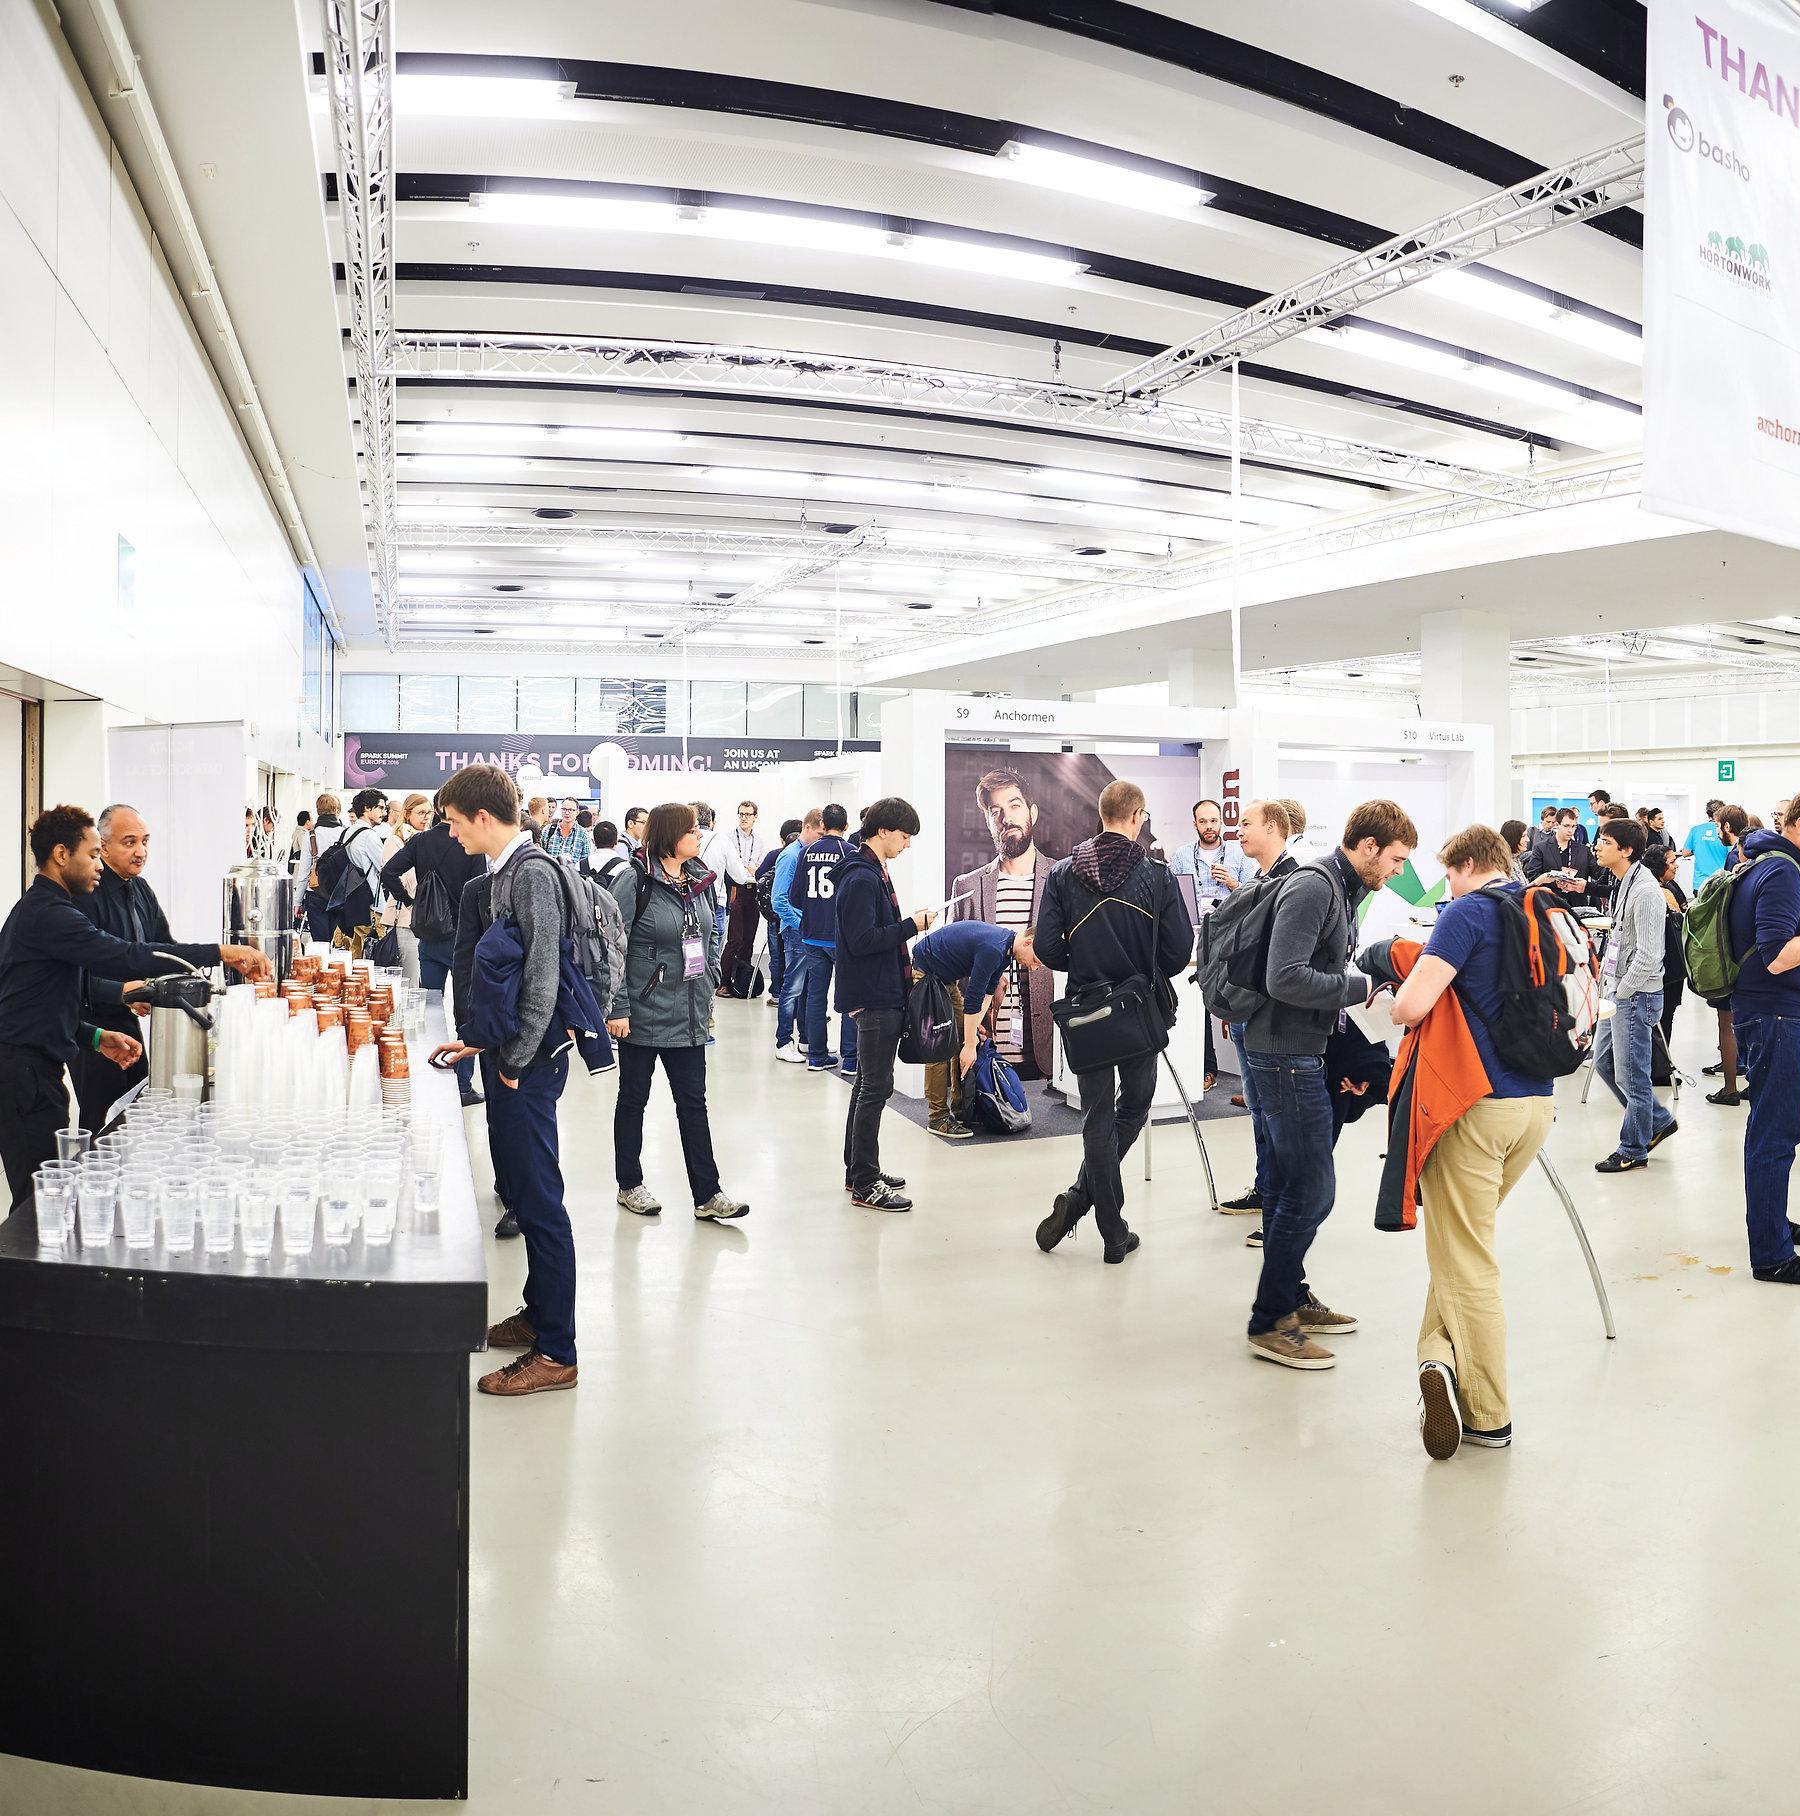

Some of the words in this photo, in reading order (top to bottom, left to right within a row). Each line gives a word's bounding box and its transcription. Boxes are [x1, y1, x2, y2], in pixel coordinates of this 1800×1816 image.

[1699, 131, 1750, 182] basho
[956, 707, 970, 719] S9
[994, 710, 1055, 722] Anchormen
[1403, 730, 1417, 740] S10
[1452, 732, 1464, 742] Lab
[382, 752, 409, 760] SUMMIT
[723, 748, 749, 758] JOIN
[750, 749, 765, 759] US
[766, 749, 781, 759] AT
[723, 760, 740, 770] AN
[807, 865, 835, 899] 16
